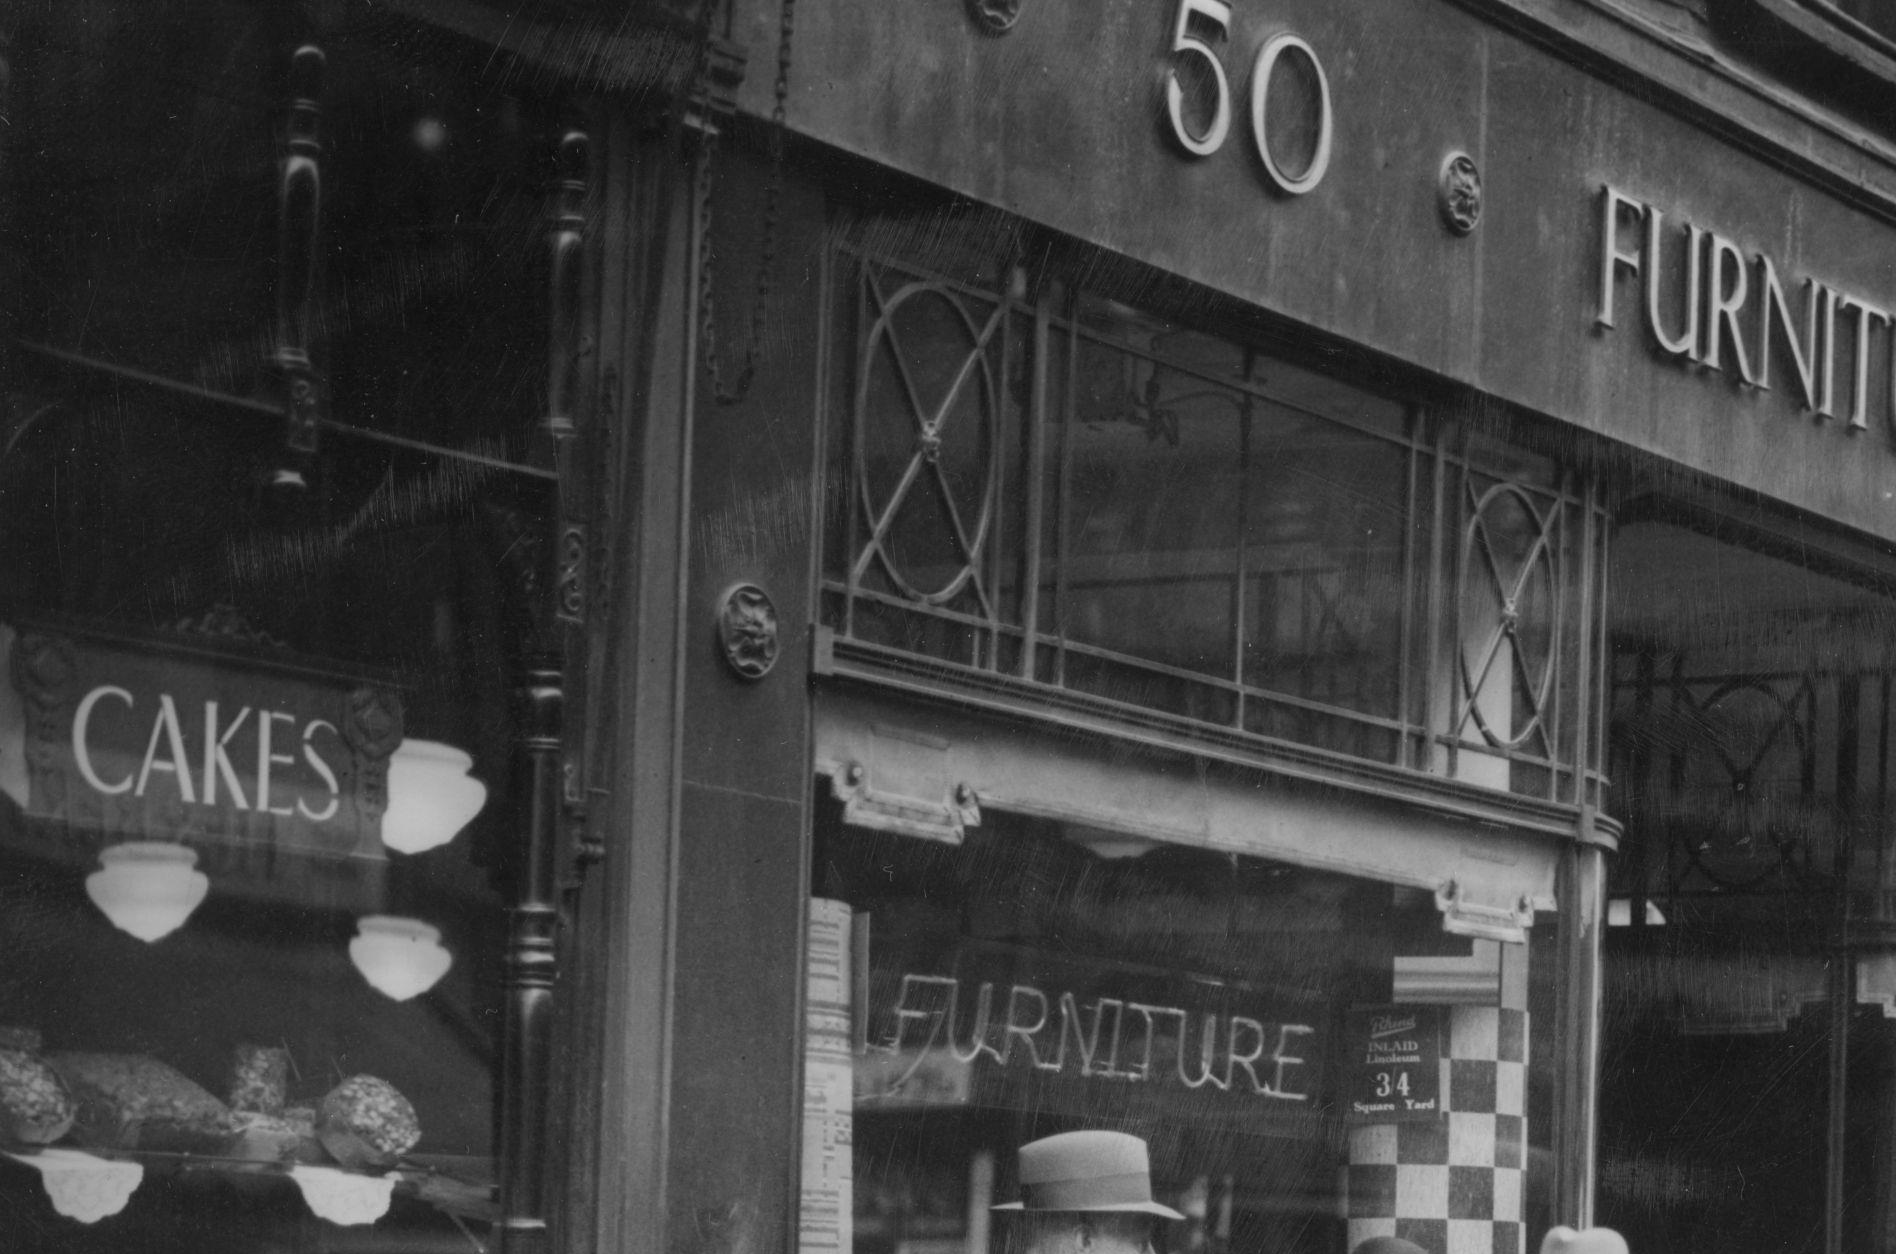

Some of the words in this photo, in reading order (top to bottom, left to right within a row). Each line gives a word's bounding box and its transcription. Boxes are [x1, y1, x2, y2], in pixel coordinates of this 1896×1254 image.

[1168, 0, 1332, 194] 50
[72, 685, 339, 821] CAKES
[892, 973, 1314, 1101] FURNITURE
[1366, 1053, 1420, 1064] Linoleum
[1368, 1040, 1419, 1053] INLAID
[1353, 1101, 1395, 1114] Square
[1405, 1098, 1434, 1110] Yard
